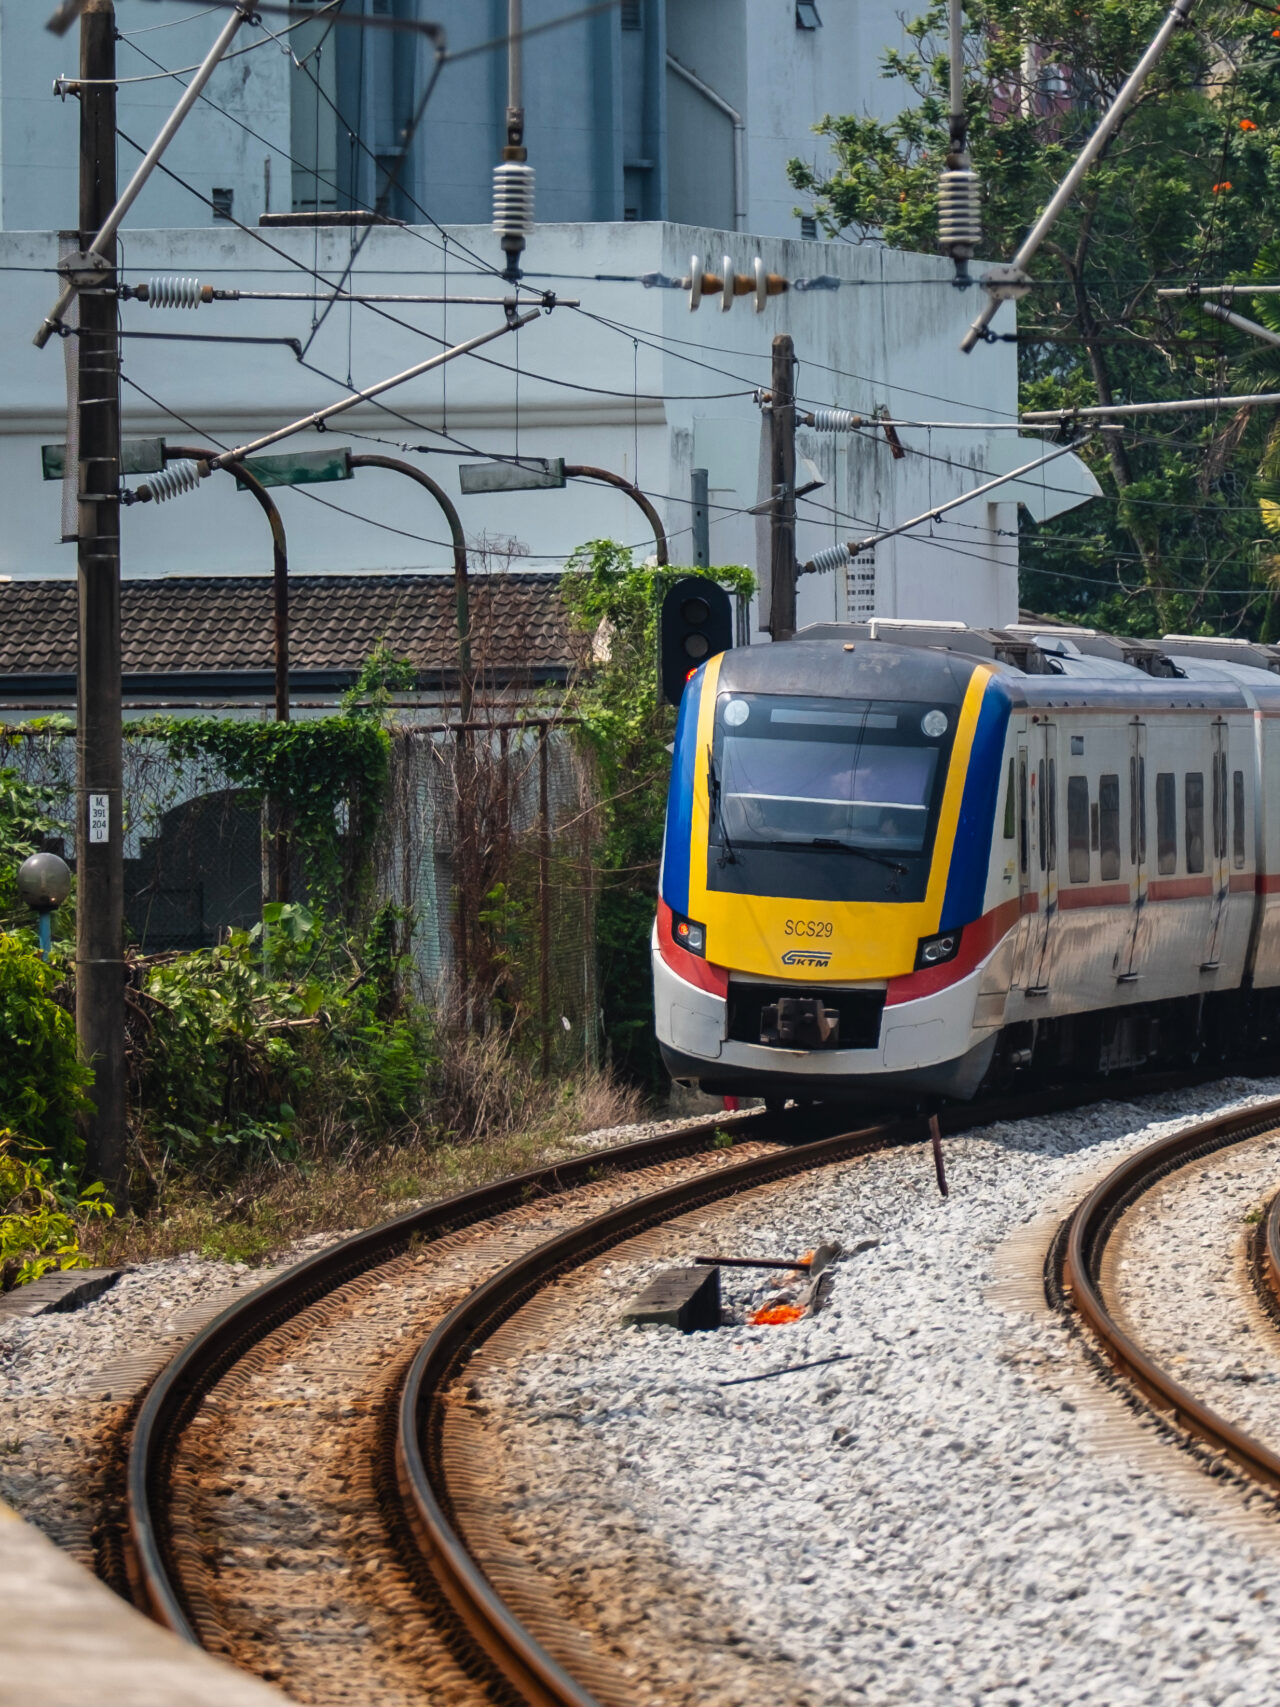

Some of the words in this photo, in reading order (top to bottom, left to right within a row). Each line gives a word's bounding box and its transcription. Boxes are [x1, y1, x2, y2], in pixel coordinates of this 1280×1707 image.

[96, 830, 103, 839] U
[784, 919, 833, 938] SCS29
[796, 958, 829, 968] KTM
